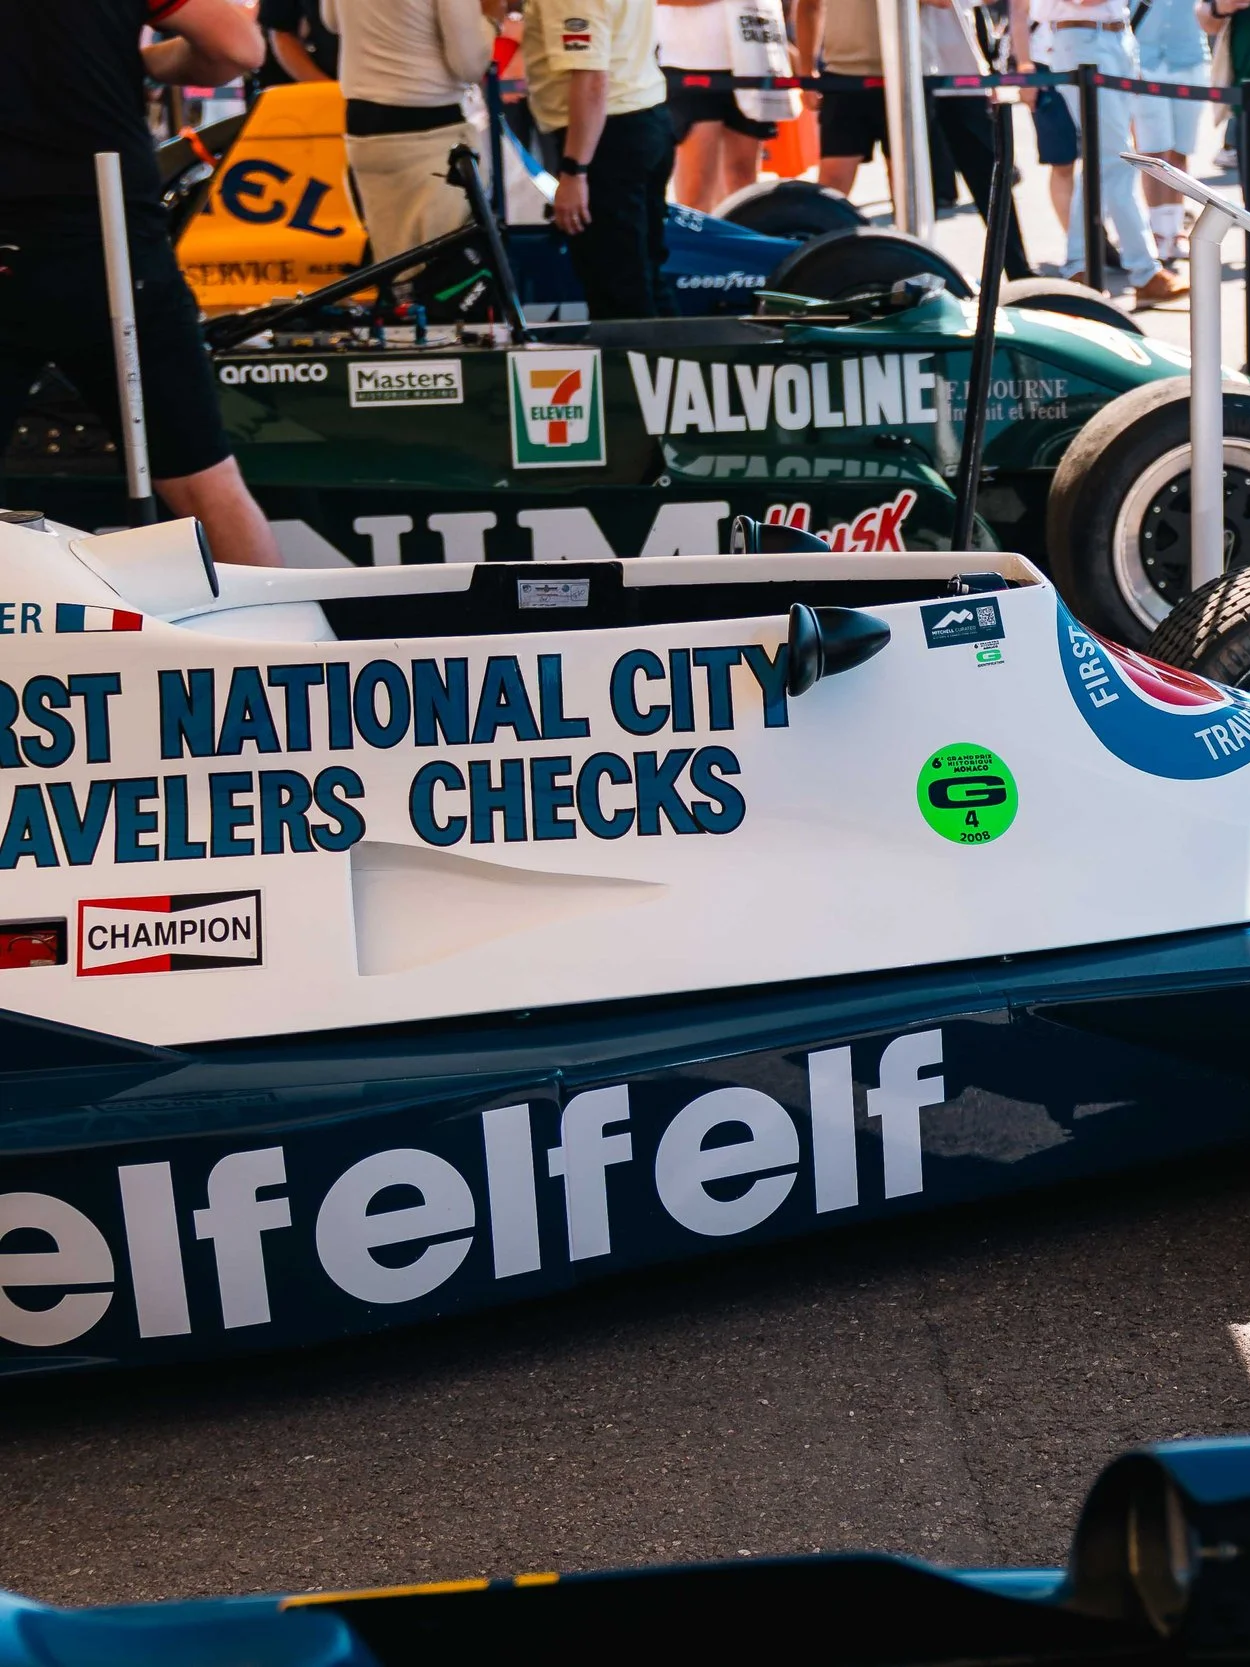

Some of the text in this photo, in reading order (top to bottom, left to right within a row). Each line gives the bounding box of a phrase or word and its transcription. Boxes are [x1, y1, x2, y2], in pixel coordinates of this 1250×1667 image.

[203, 158, 344, 238] EL
[676, 271, 767, 291] GOODYEA
[219, 363, 328, 385] aramco
[357, 370, 455, 390] Masters
[530, 369, 582, 445] 7
[627, 350, 938, 435] VALVOLINE
[0, 602, 44, 634] ER
[1068, 625, 1120, 709] FIRST
[157, 654, 590, 760] NATIONAL
[609, 642, 789, 737] CITY
[954, 765, 989, 773] MONACO
[0, 746, 746, 869] AVELERS CHECKS
[928, 775, 1007, 809] G
[965, 810, 979, 827] 4
[960, 830, 991, 842] 2008
[88, 916, 251, 951] CHAMPION
[316, 1084, 633, 1304] elf
[655, 1028, 945, 1237] elf
